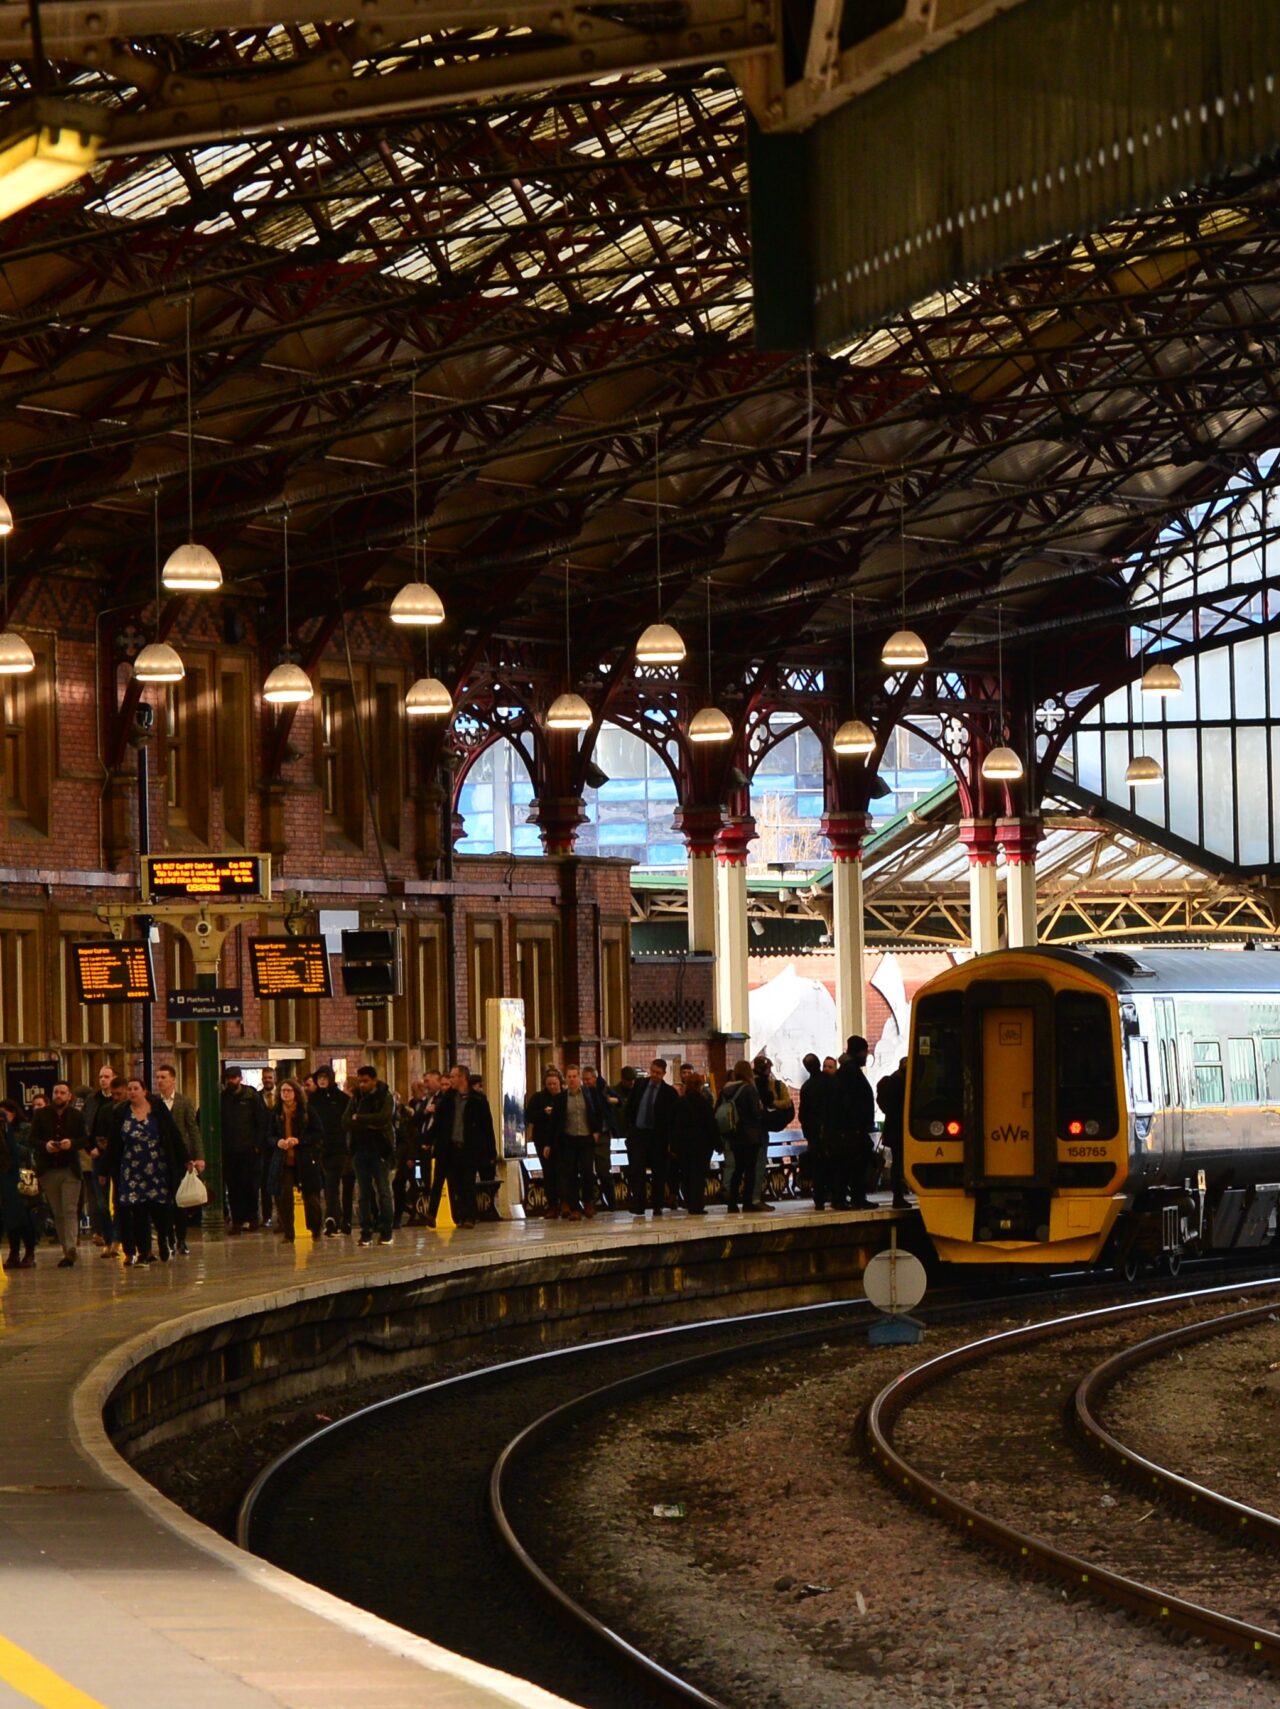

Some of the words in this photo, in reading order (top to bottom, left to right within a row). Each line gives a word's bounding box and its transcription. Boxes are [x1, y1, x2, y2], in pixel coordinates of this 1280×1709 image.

[194, 862, 214, 870] Central
[991, 1124, 1030, 1143] GWR
[935, 1147, 944, 1157] A
[1068, 1147, 1107, 1157] 158765
